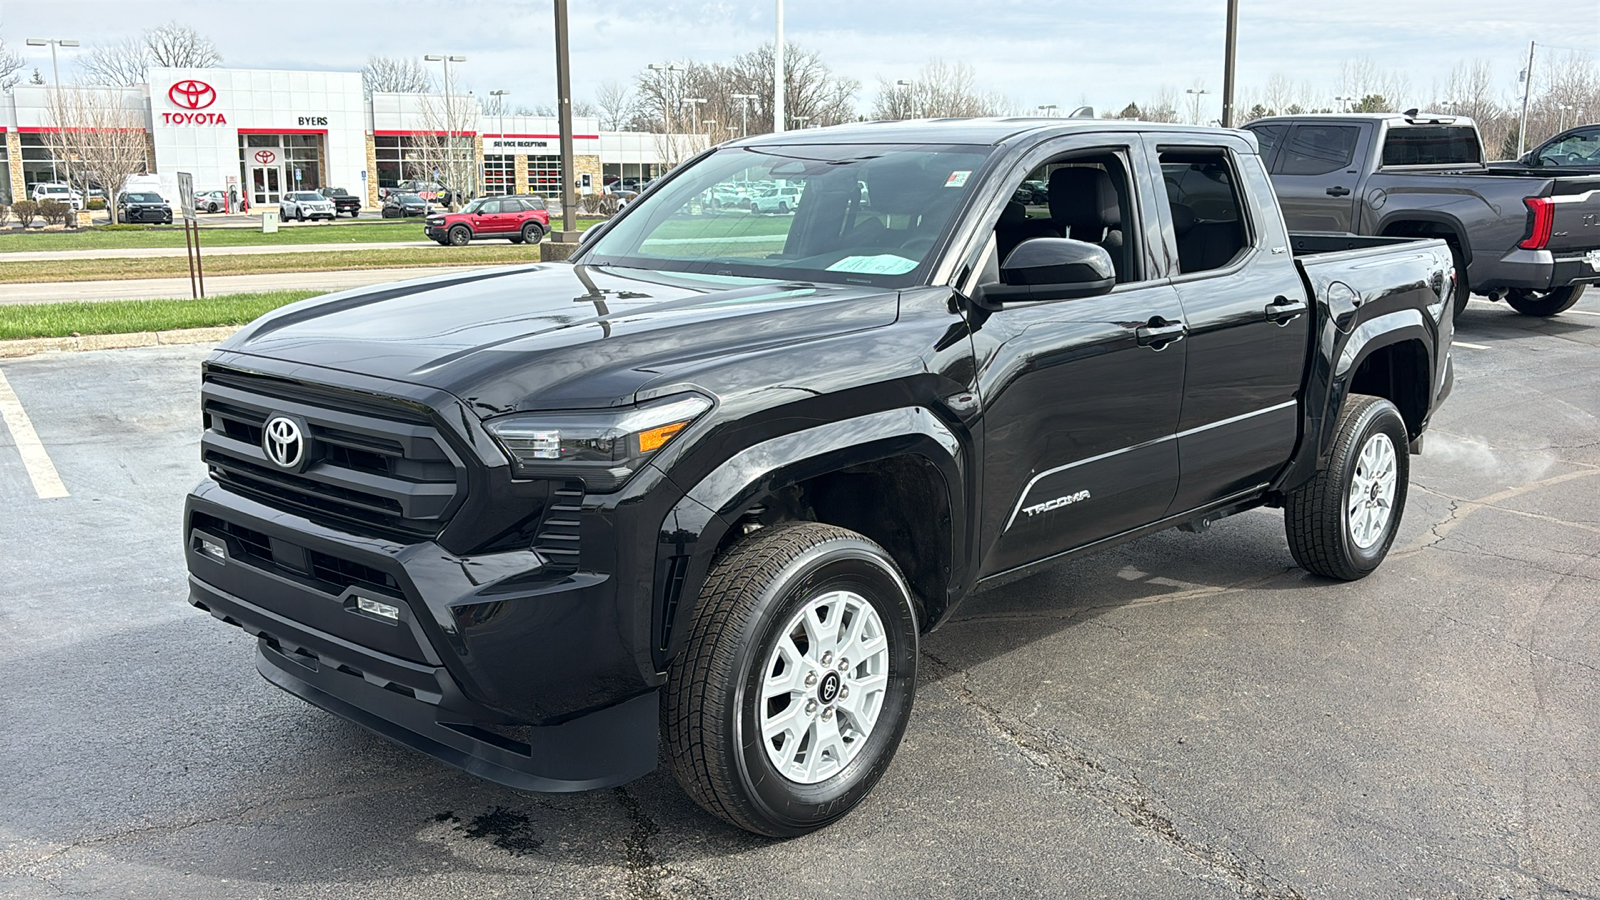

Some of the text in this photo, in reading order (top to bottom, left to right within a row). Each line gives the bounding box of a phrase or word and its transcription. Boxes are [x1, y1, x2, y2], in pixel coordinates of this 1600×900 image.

[162, 112, 227, 125] TOYOTA
[298, 116, 328, 126] BYERS
[1022, 489, 1091, 517] TACOMA
